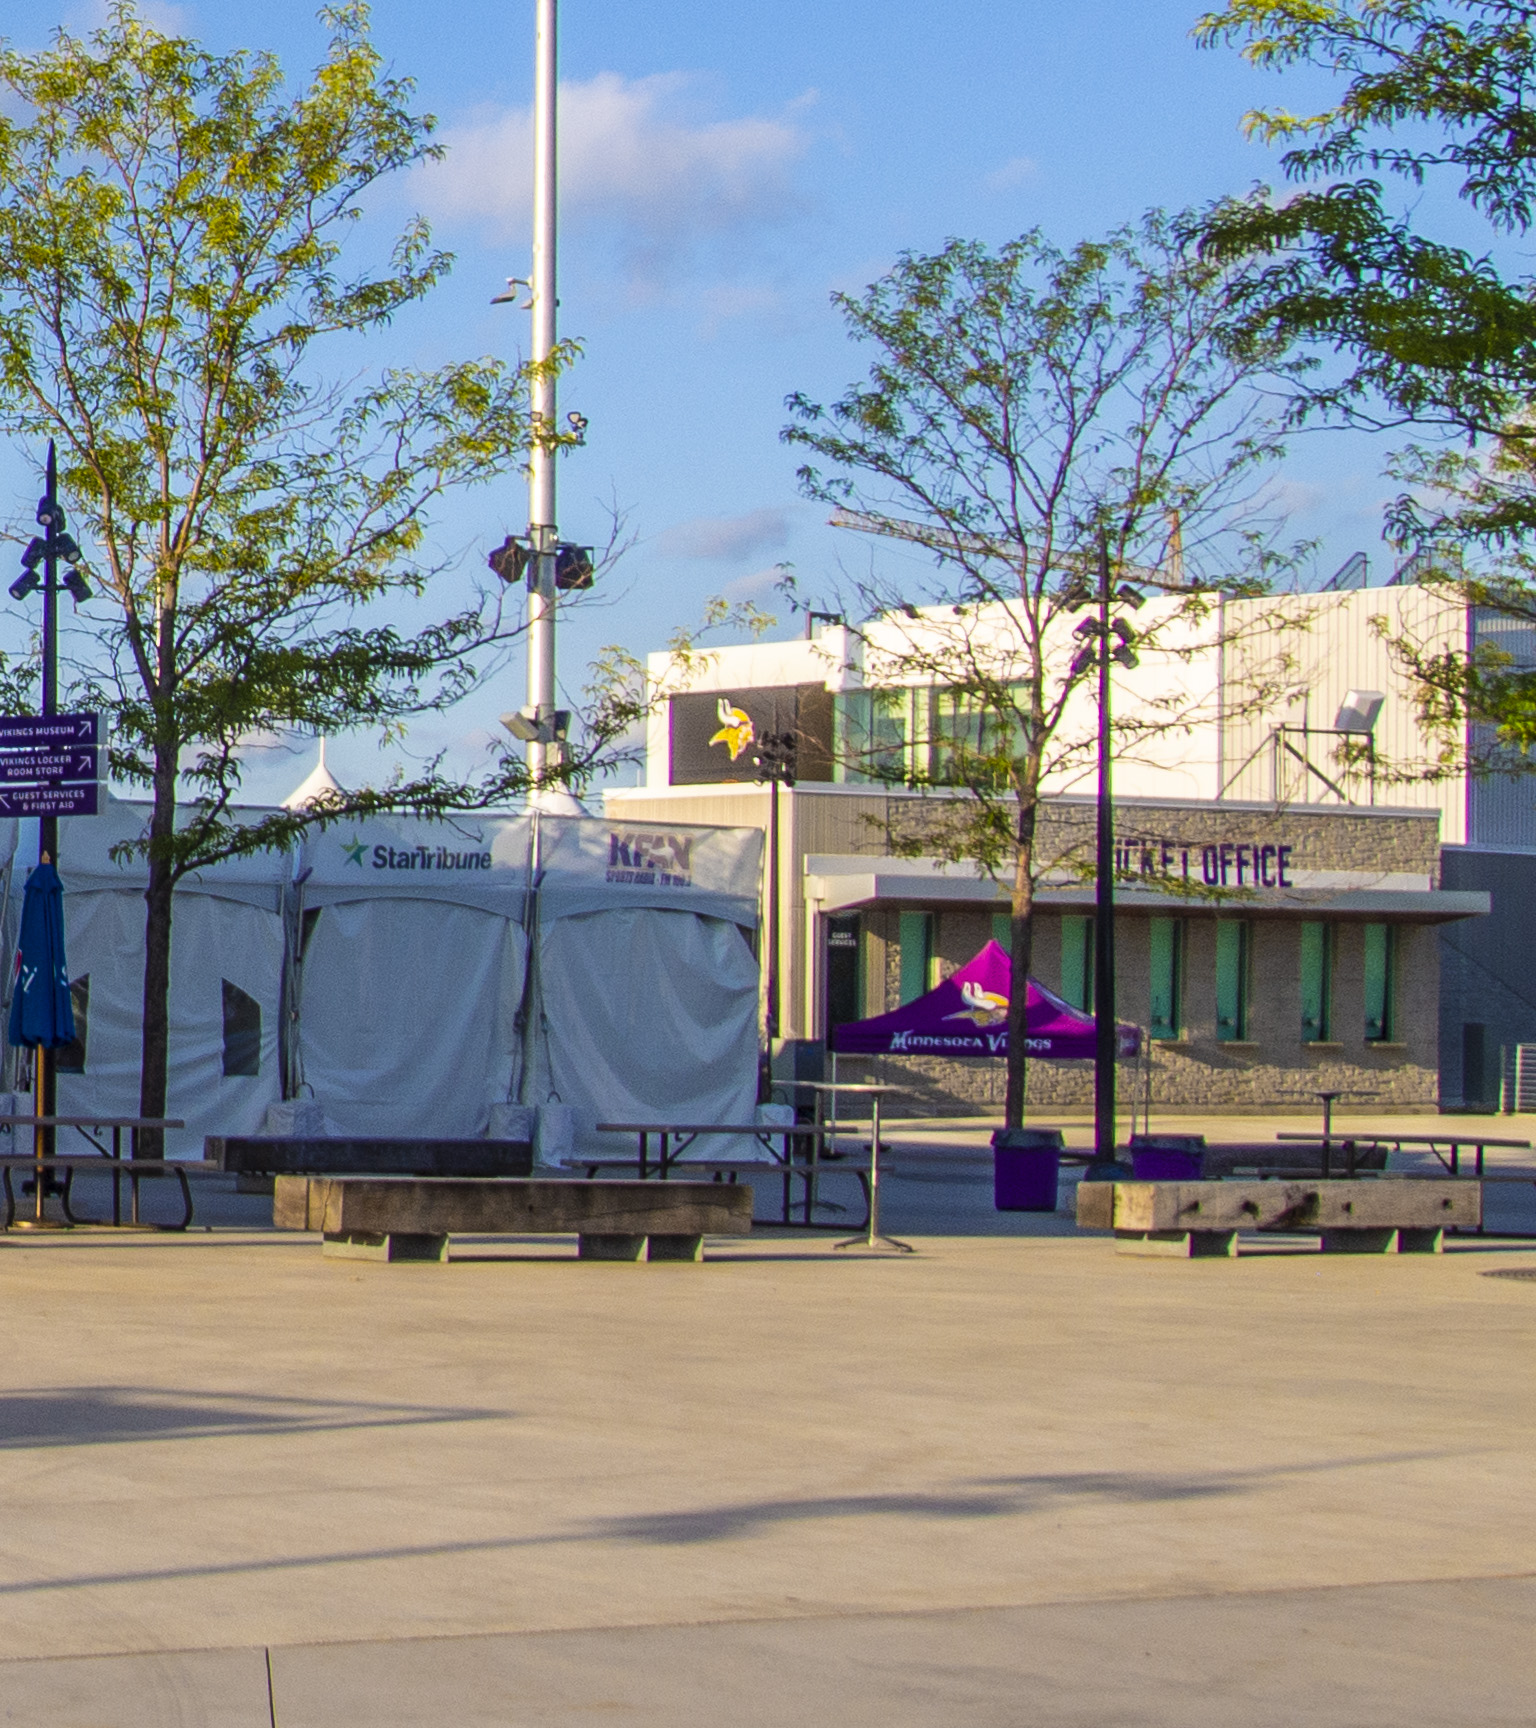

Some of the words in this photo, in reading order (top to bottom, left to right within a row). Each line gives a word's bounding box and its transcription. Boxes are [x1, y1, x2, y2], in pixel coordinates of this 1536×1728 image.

[35, 726, 75, 736] MUSEUM
[0, 756, 35, 766] VIKINGS
[37, 755, 72, 765] LOCKER
[7, 768, 33, 776] ROOM
[35, 766, 64, 775] STORE
[12, 792, 40, 801] GUEST
[42, 790, 85, 799] SERVICES
[31, 802, 56, 810] FIRST
[58, 801, 75, 809] AID
[372, 844, 492, 869] StarTribune
[608, 832, 692, 871] KFAN
[1115, 838, 1190, 884] ICKET
[1202, 843, 1293, 888] OFFICE
[986, 1031, 1052, 1052] VINGS
